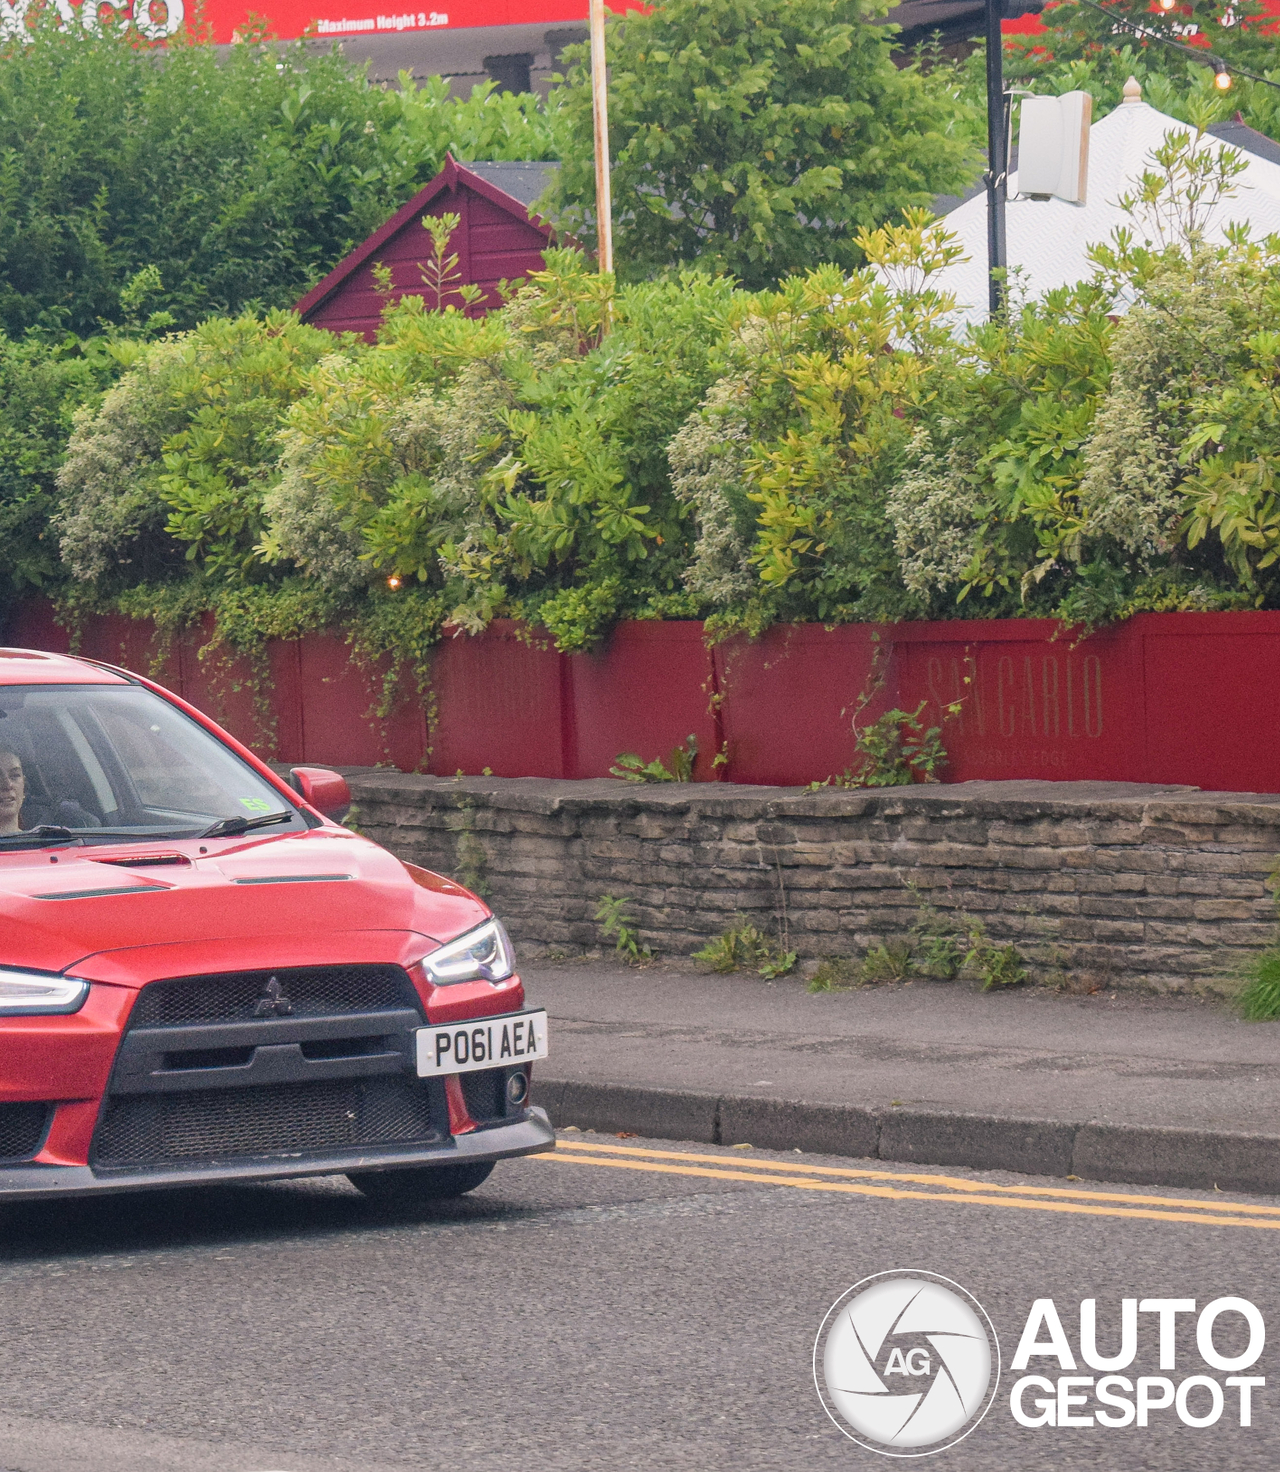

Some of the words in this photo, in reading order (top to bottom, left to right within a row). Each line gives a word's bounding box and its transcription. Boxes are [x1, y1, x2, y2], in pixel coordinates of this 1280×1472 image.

[317, 18, 375, 33] Maximum
[376, 14, 415, 30] Height
[418, 12, 449, 27] 3.2m
[997, 655, 1103, 738] CARLO
[436, 1027, 493, 1067] PO61
[500, 1019, 537, 1059] AEA
